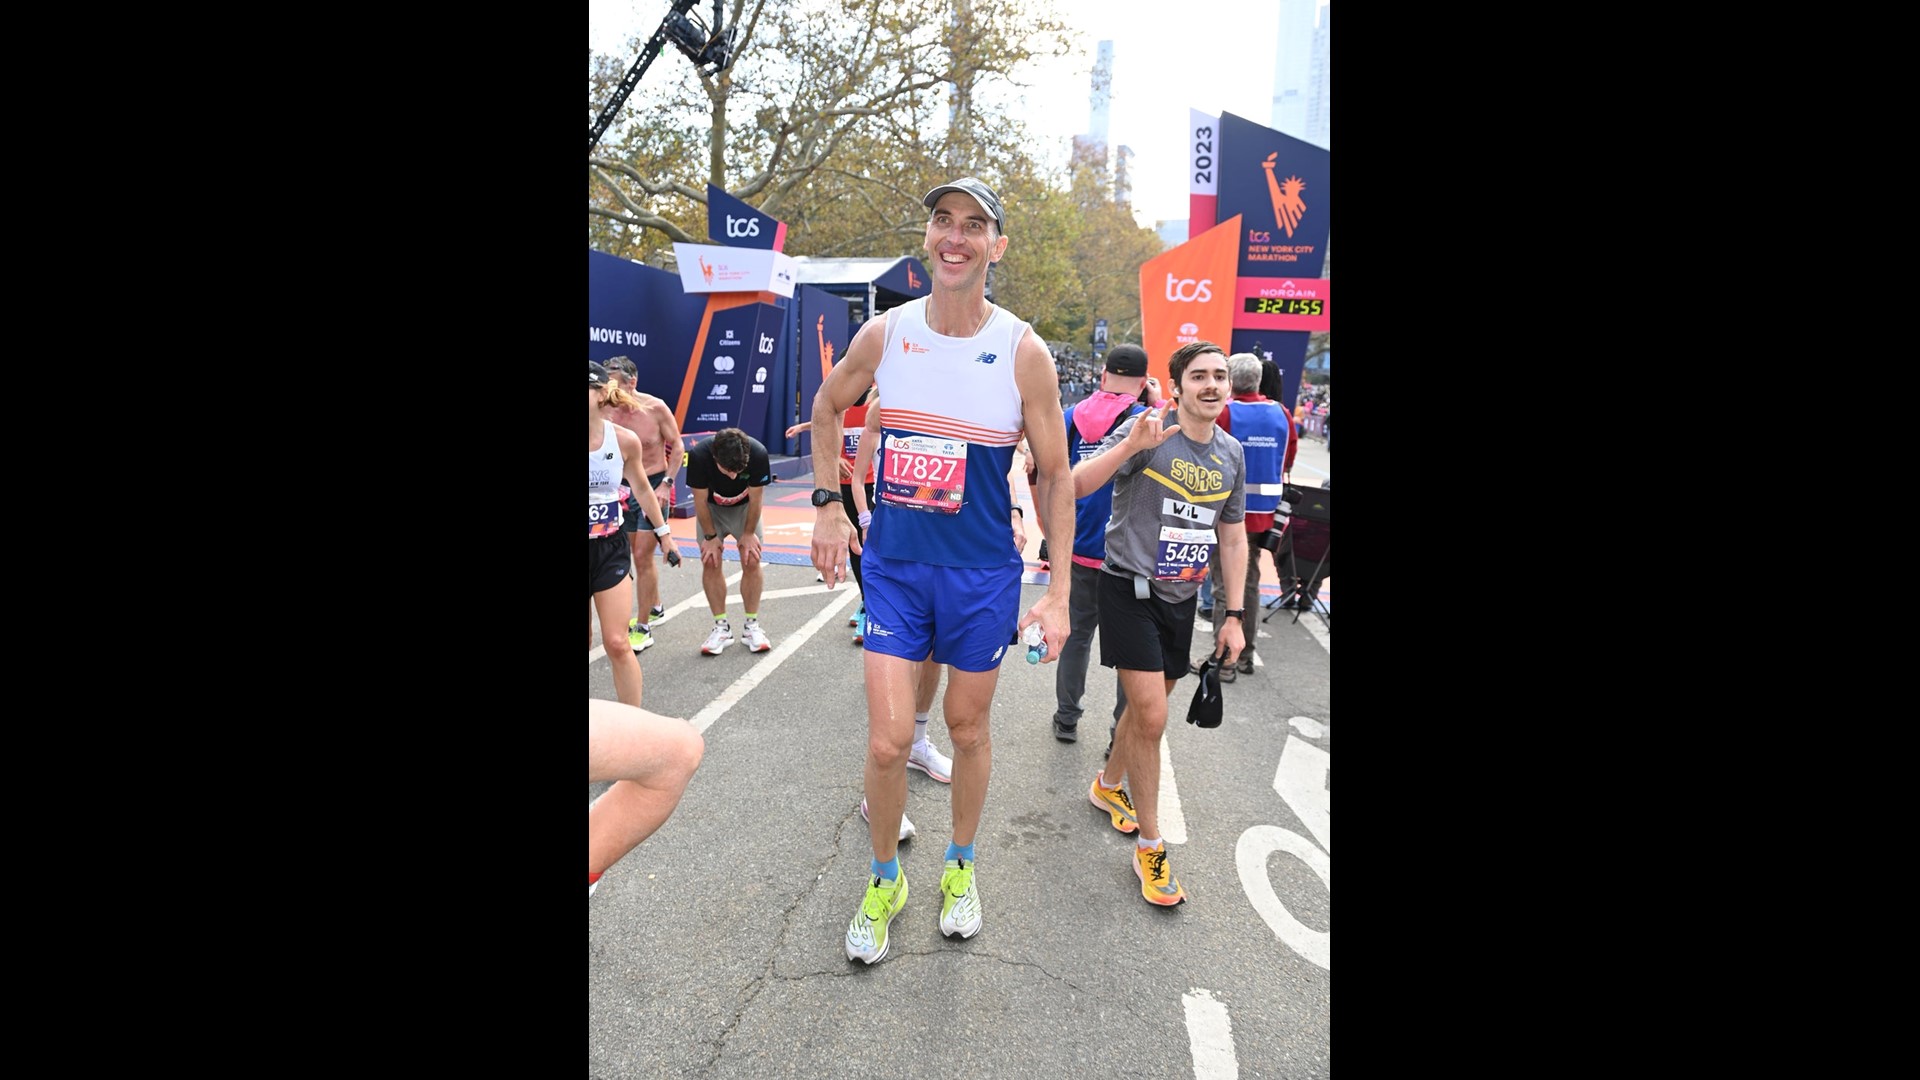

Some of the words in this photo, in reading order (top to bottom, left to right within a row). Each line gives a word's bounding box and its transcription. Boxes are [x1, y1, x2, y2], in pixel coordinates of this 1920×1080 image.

[1195, 126, 1212, 184] 2023
[726, 214, 760, 237] tcs
[1249, 229, 1270, 243] tcs
[1248, 245, 1269, 253] NEW
[1271, 245, 1293, 253] YORK
[1294, 245, 1314, 254] CITY
[1248, 253, 1297, 262] MARATHON
[1165, 272, 1212, 302] tcs
[1260, 288, 1316, 298] NORQAIN
[590, 326, 623, 345] MOVE
[625, 331, 647, 347] YOU
[759, 332, 774, 354] tcs
[892, 453, 957, 482] 17827
[1171, 458, 1222, 491] SBRC
[1165, 542, 1210, 563] 5436
